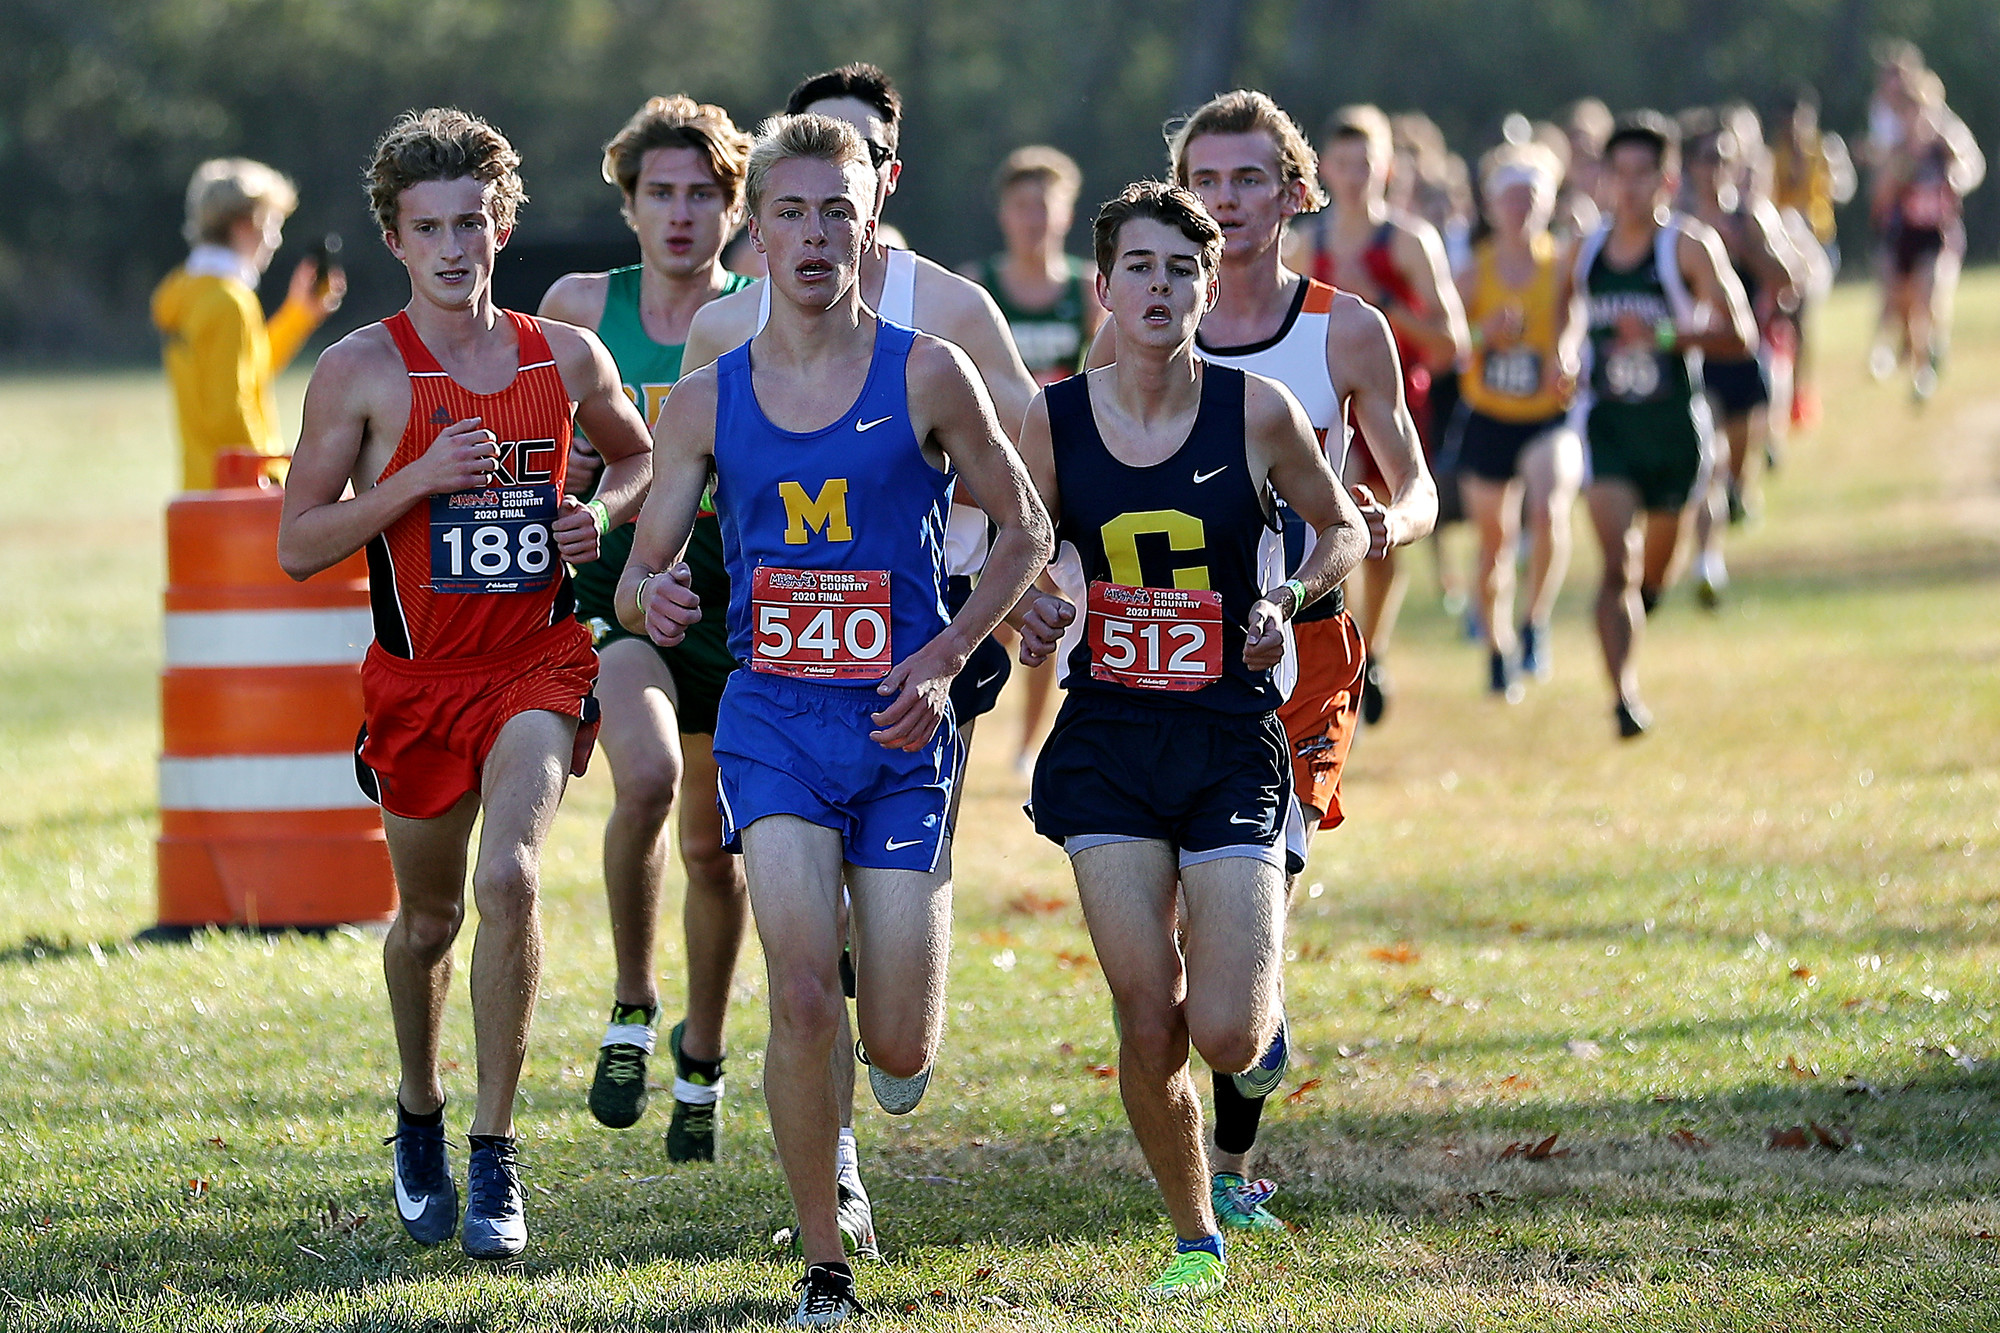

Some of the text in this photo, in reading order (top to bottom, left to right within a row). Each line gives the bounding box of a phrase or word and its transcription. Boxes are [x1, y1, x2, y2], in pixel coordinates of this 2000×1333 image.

[502, 490, 534, 499] CROSS
[502, 497, 544, 507] COUNTRY
[474, 509, 526, 519] 2020 FINAL
[778, 478, 852, 544] M
[442, 523, 550, 576] 188
[820, 574, 855, 583] CROSS
[820, 582, 868, 591] COUNTRY
[791, 592, 845, 602] 2020 FINAL
[1153, 591, 1189, 600] CROSS
[1153, 600, 1201, 609] COUNTRY
[1125, 607, 1178, 617] 2020 FINAL
[757, 606, 887, 660] 540
[1101, 619, 1206, 672] 512
